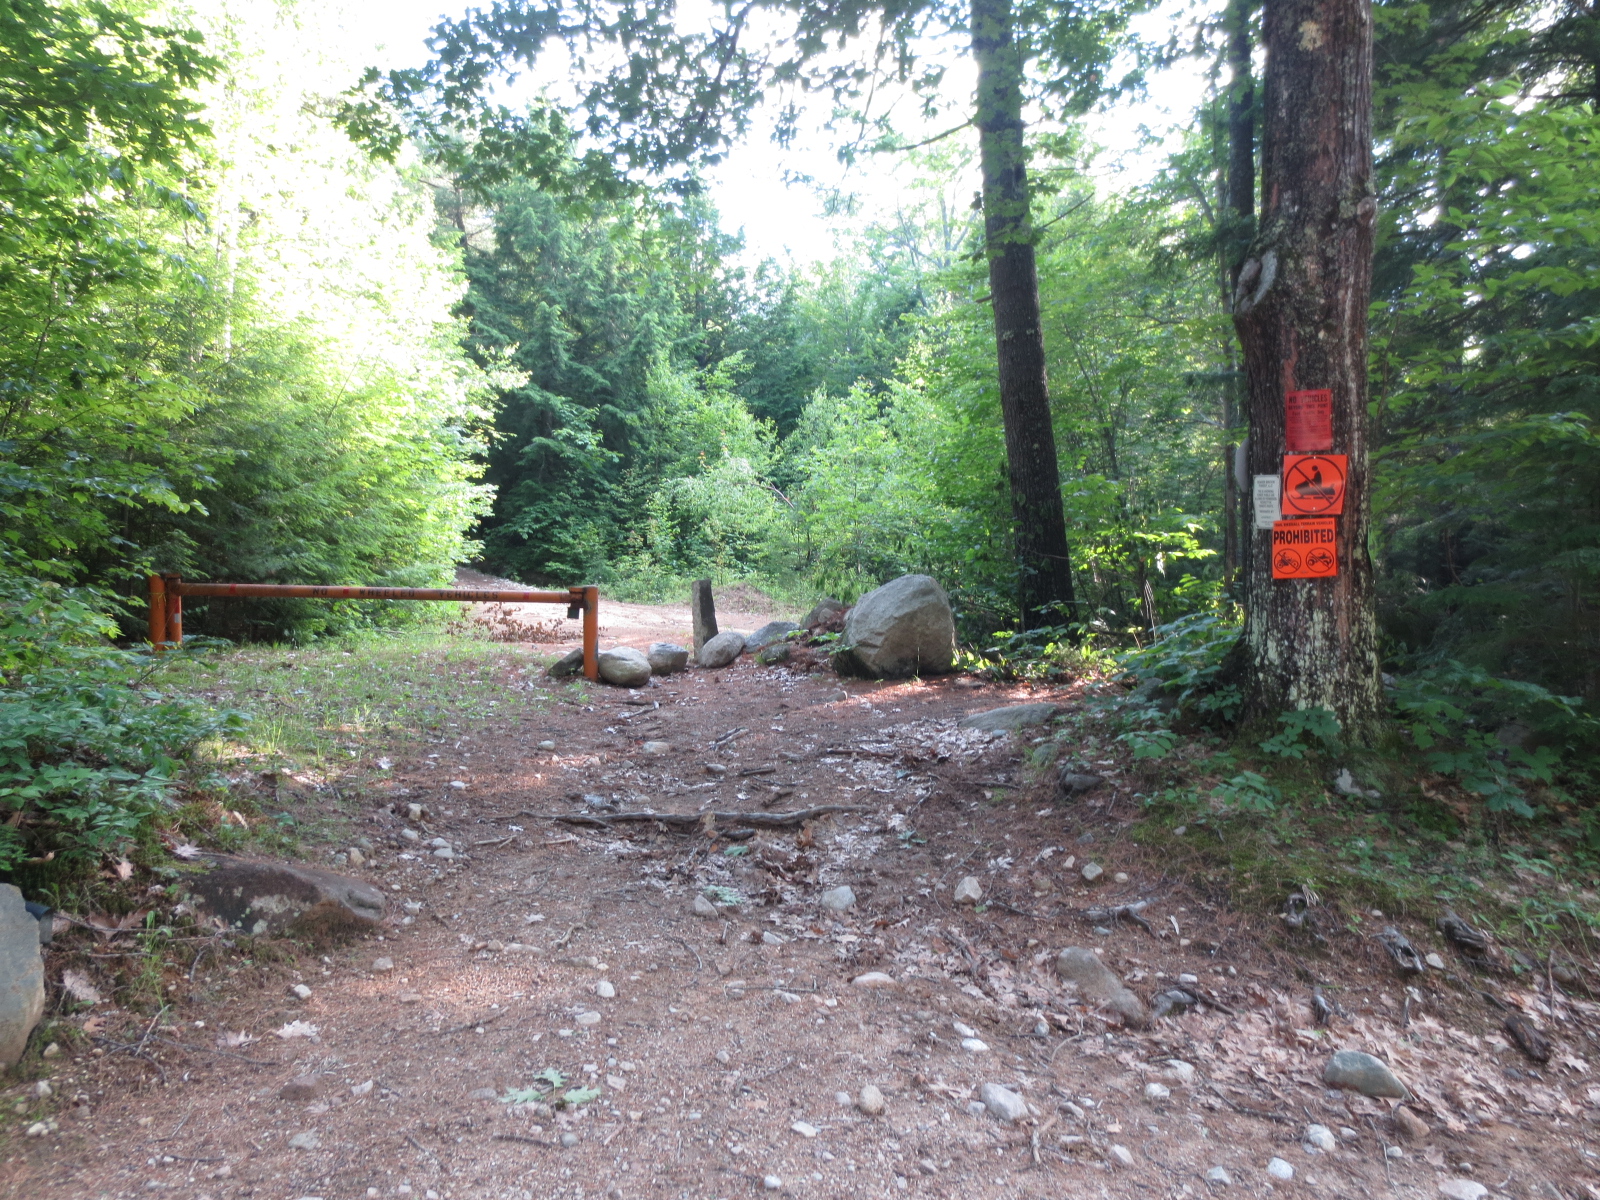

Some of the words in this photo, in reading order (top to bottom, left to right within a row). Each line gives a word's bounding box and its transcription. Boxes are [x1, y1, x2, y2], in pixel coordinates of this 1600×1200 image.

[1288, 396, 1297, 404] NO
[1273, 529, 1334, 545] PROHIBITED
[312, 588, 328, 596] NO
[359, 588, 415, 598] WHEELED
[439, 590, 499, 600] VEHICLES
